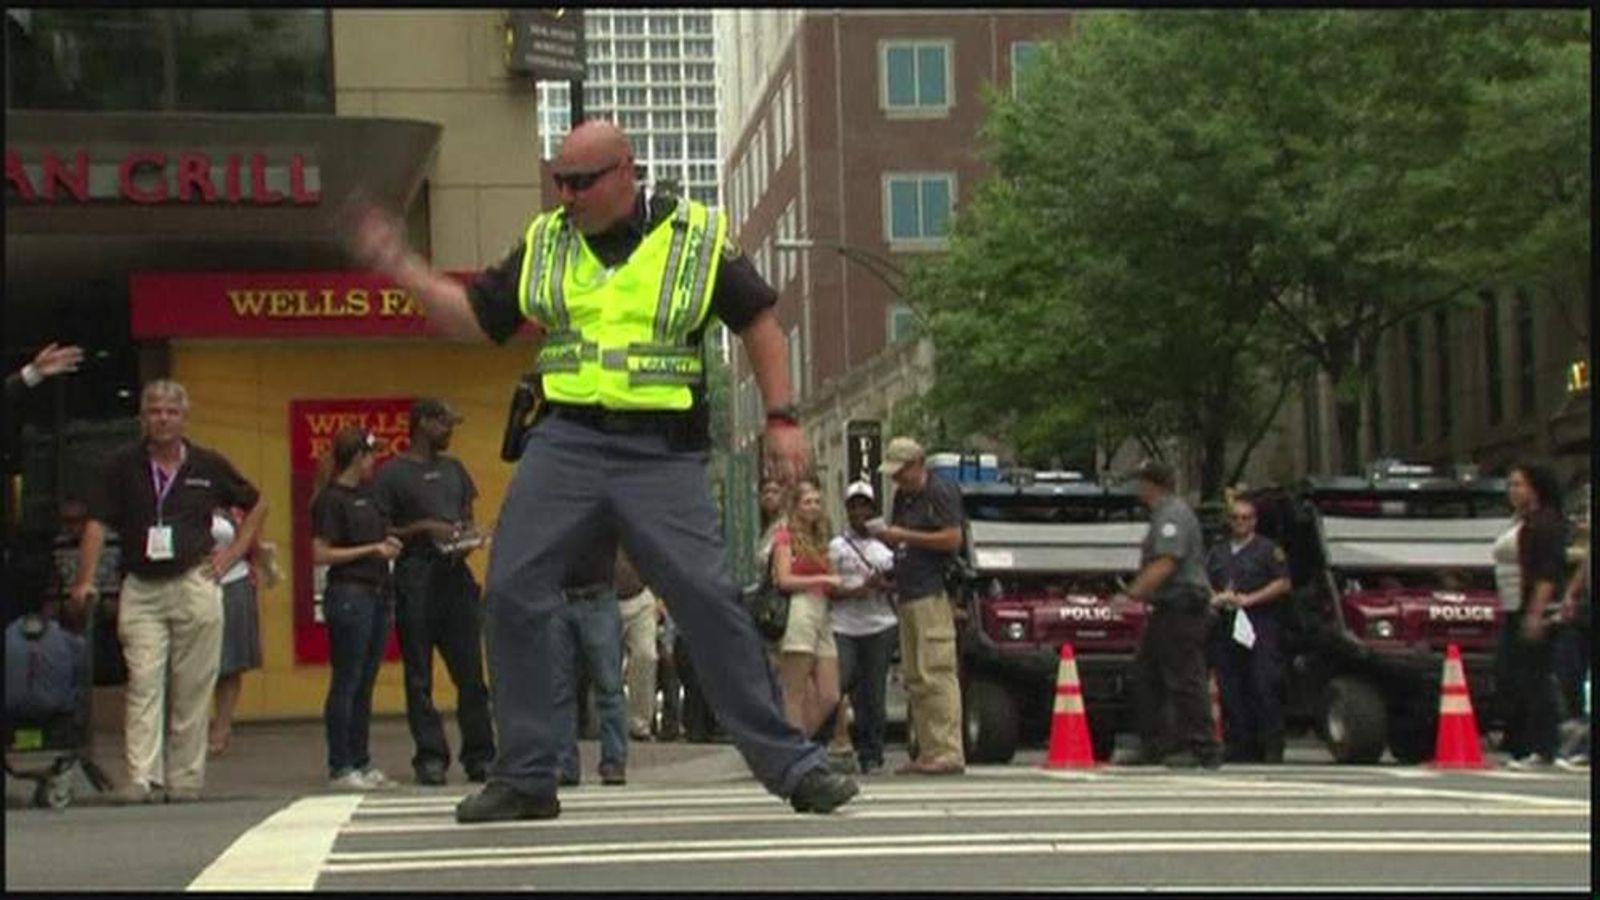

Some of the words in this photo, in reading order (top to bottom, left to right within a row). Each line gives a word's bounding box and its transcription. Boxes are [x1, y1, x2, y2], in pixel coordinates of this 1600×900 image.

[118, 150, 321, 206] GRILL
[228, 289, 370, 316] WELLS
[1429, 605, 1494, 620] POLICE
